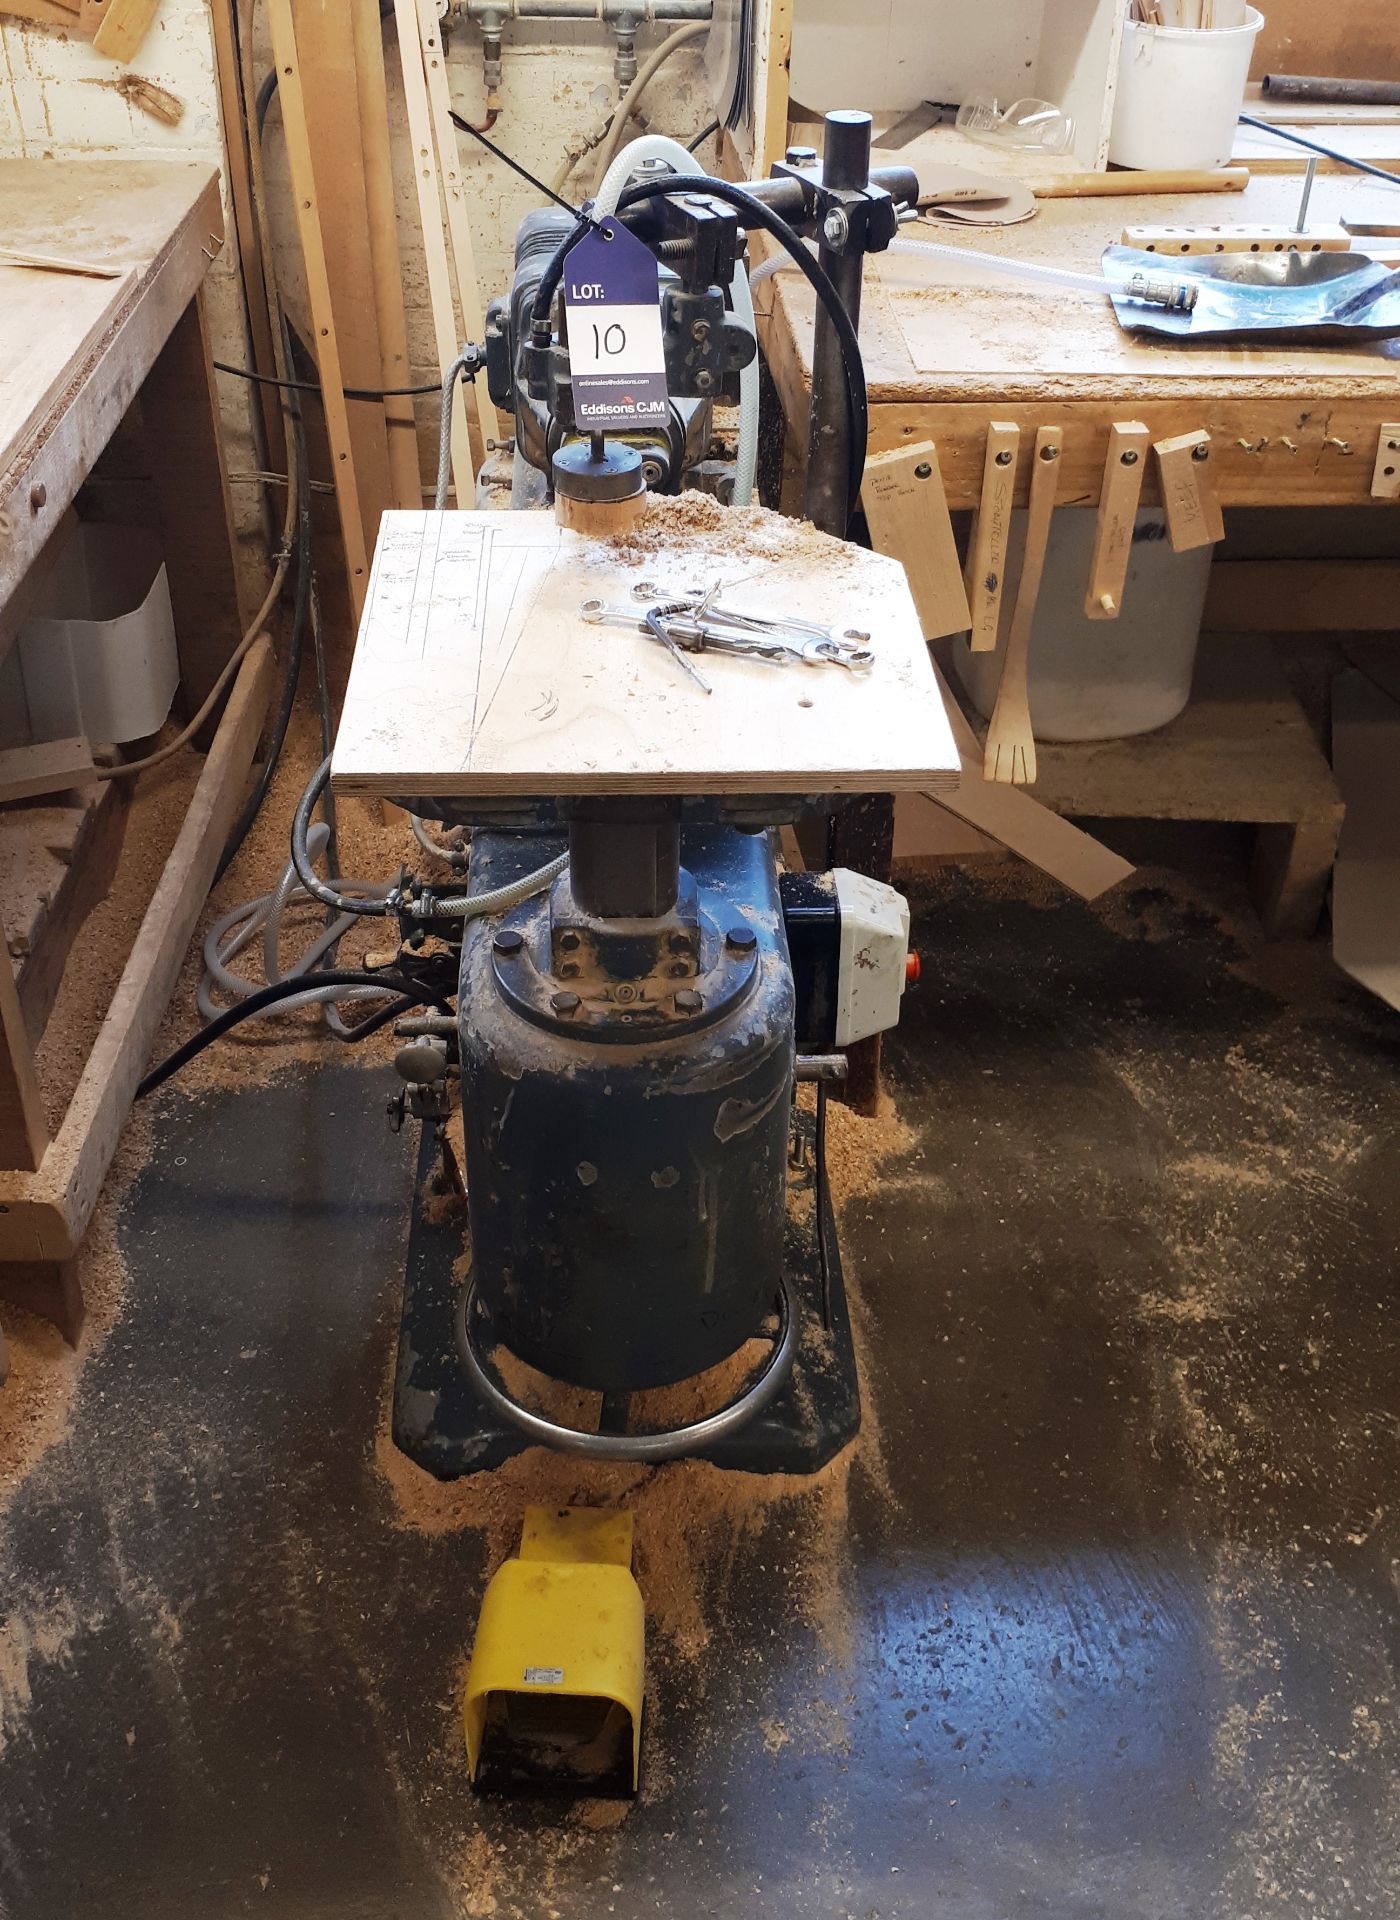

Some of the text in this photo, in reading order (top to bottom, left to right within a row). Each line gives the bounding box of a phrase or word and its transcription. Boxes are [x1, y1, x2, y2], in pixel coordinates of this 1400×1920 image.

[572, 284, 605, 299] LOT:
[592, 323, 626, 359] 10
[578, 379, 650, 387] onlinesales@eddisons.com
[580, 401, 665, 415] Eddisons CJM
